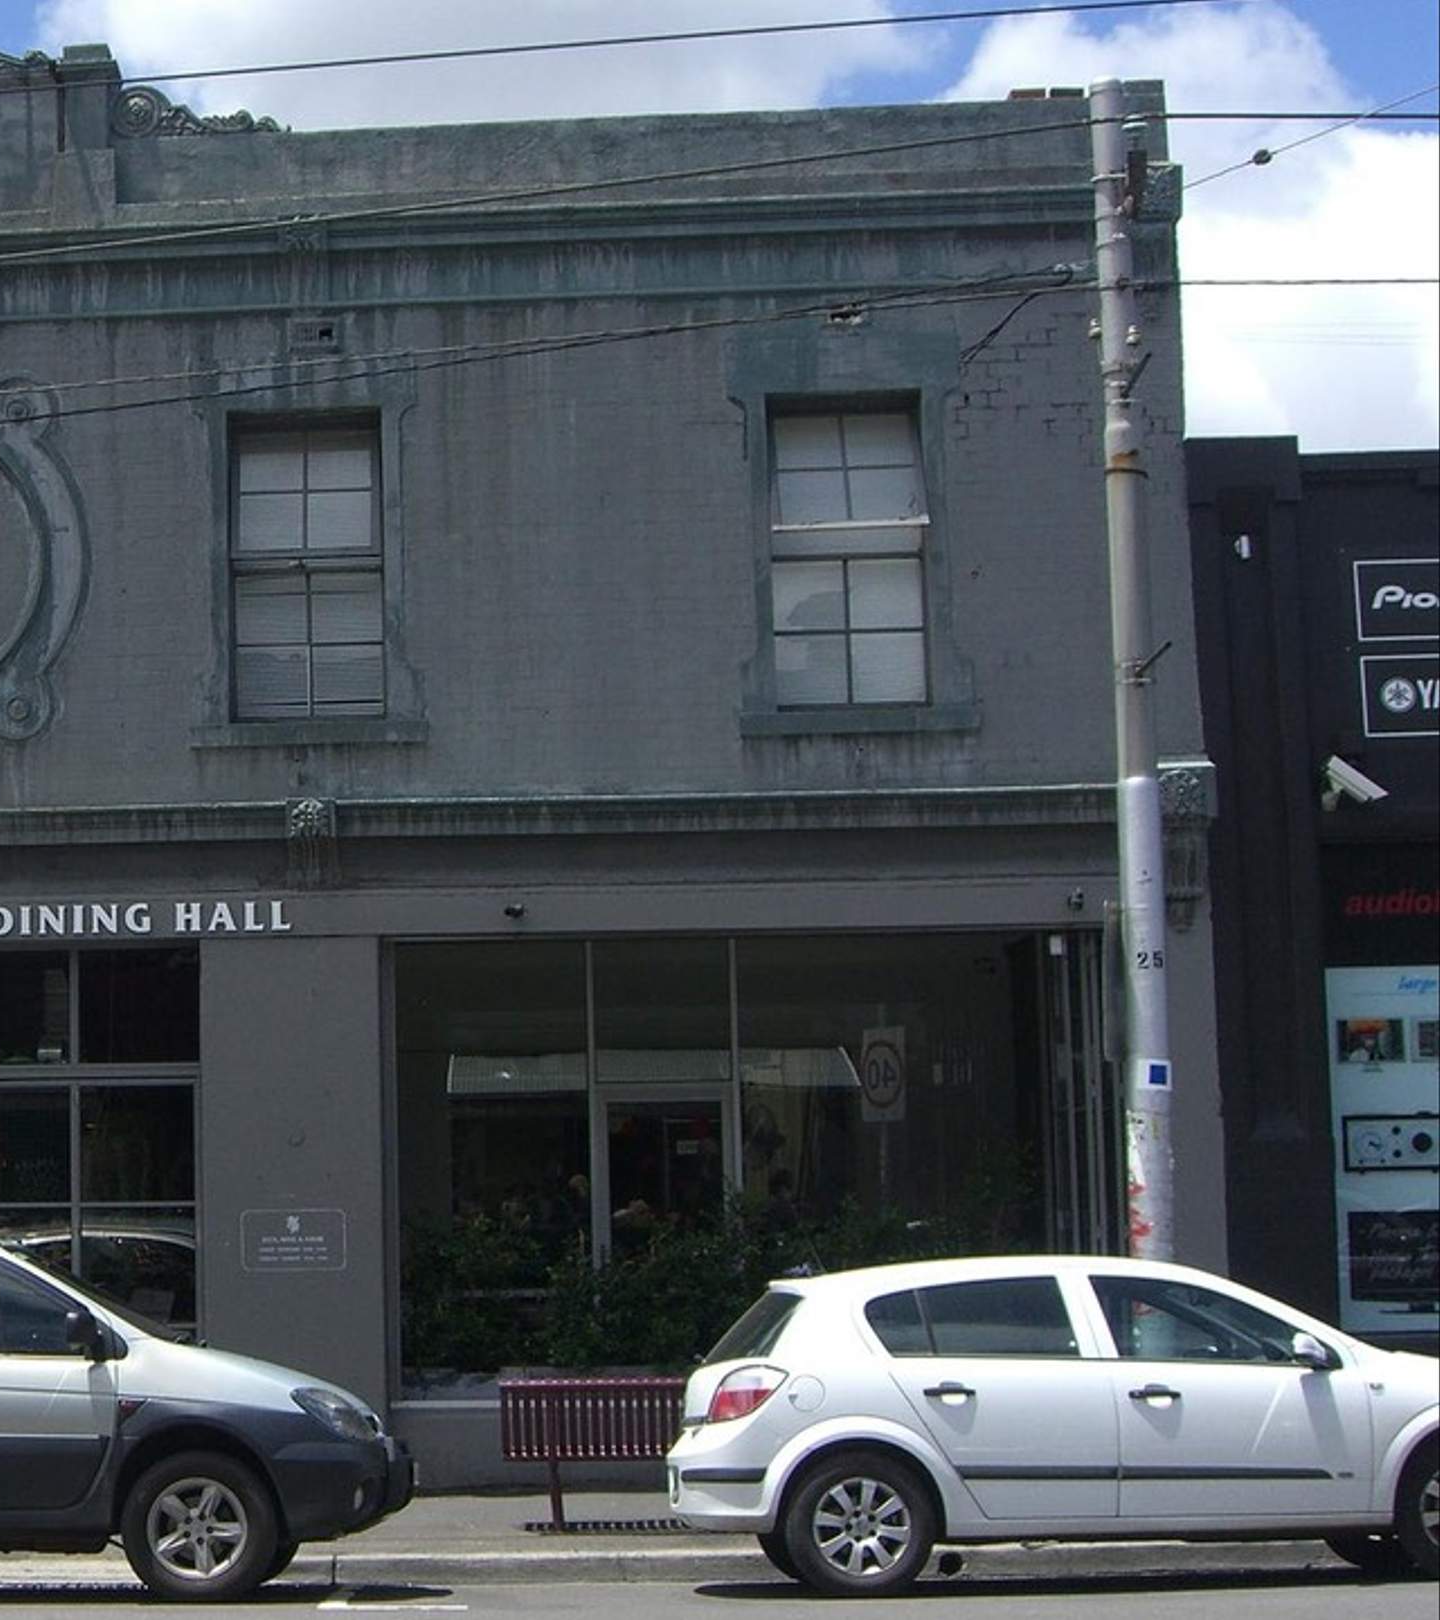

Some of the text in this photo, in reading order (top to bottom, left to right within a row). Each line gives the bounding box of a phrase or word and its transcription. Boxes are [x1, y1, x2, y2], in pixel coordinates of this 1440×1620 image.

[1371, 584, 1439, 609] Pio
[1344, 888, 1439, 916] audio
[174, 900, 292, 933] HALL
[1136, 950, 1164, 969] 25
